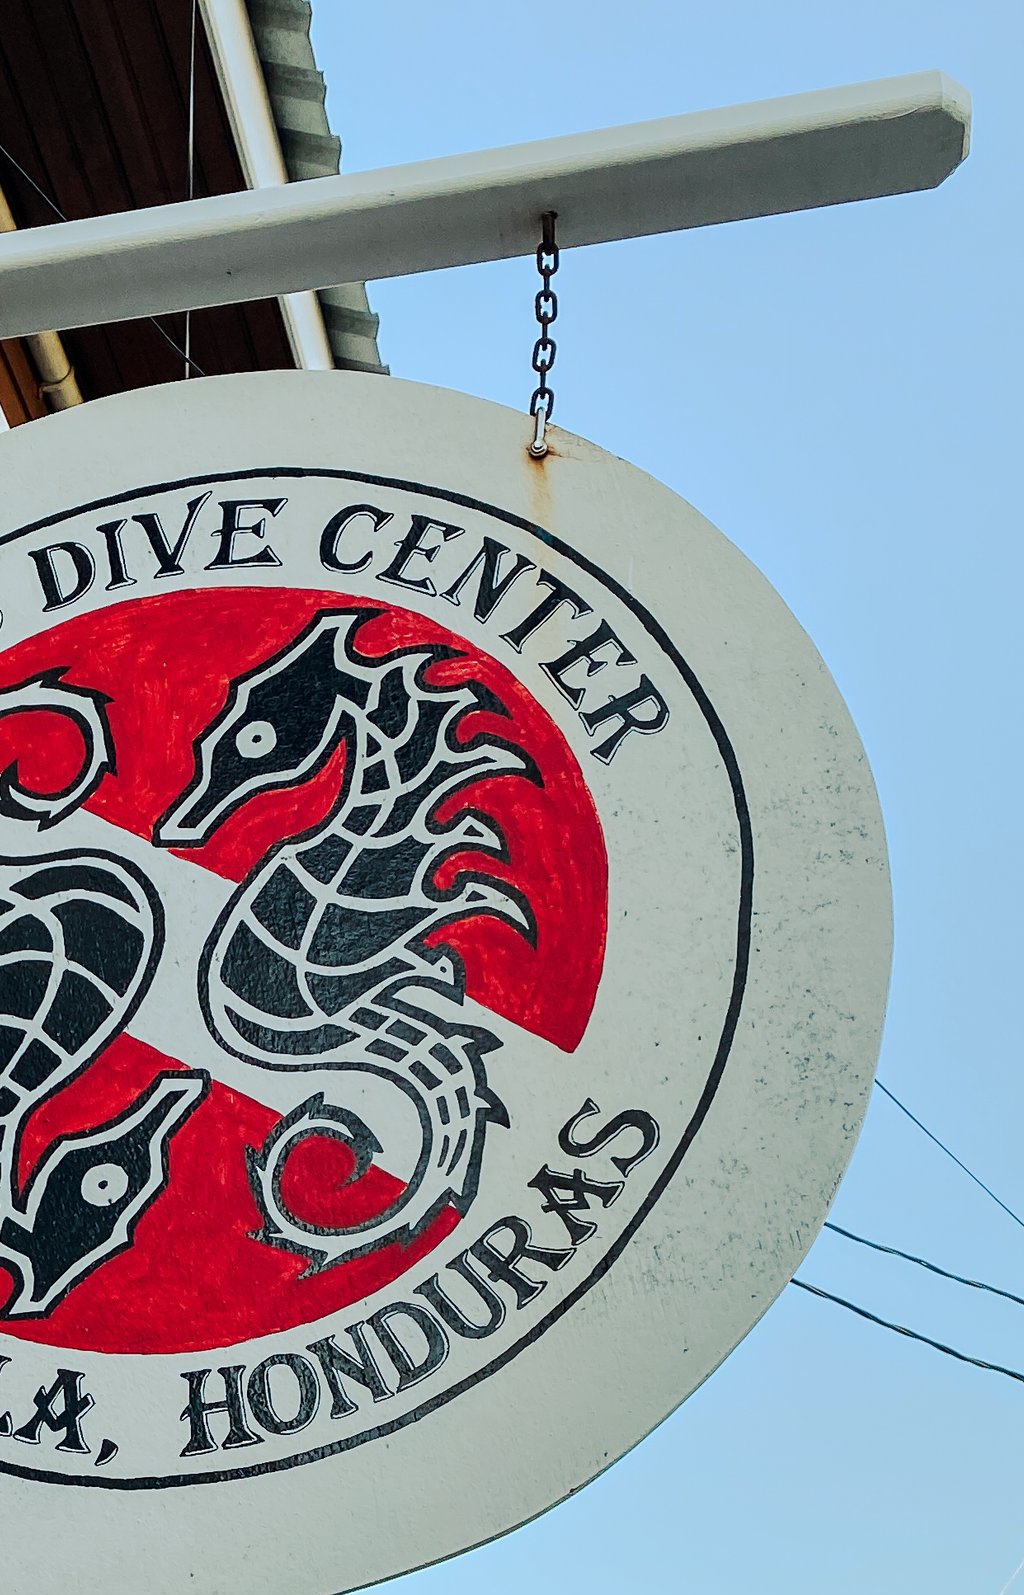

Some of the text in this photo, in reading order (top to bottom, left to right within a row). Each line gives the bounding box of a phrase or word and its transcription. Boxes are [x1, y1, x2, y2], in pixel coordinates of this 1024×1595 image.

[27, 490, 289, 614] DIVE
[317, 502, 672, 768] CENTER
[178, 1096, 660, 1458] HONDURAS
